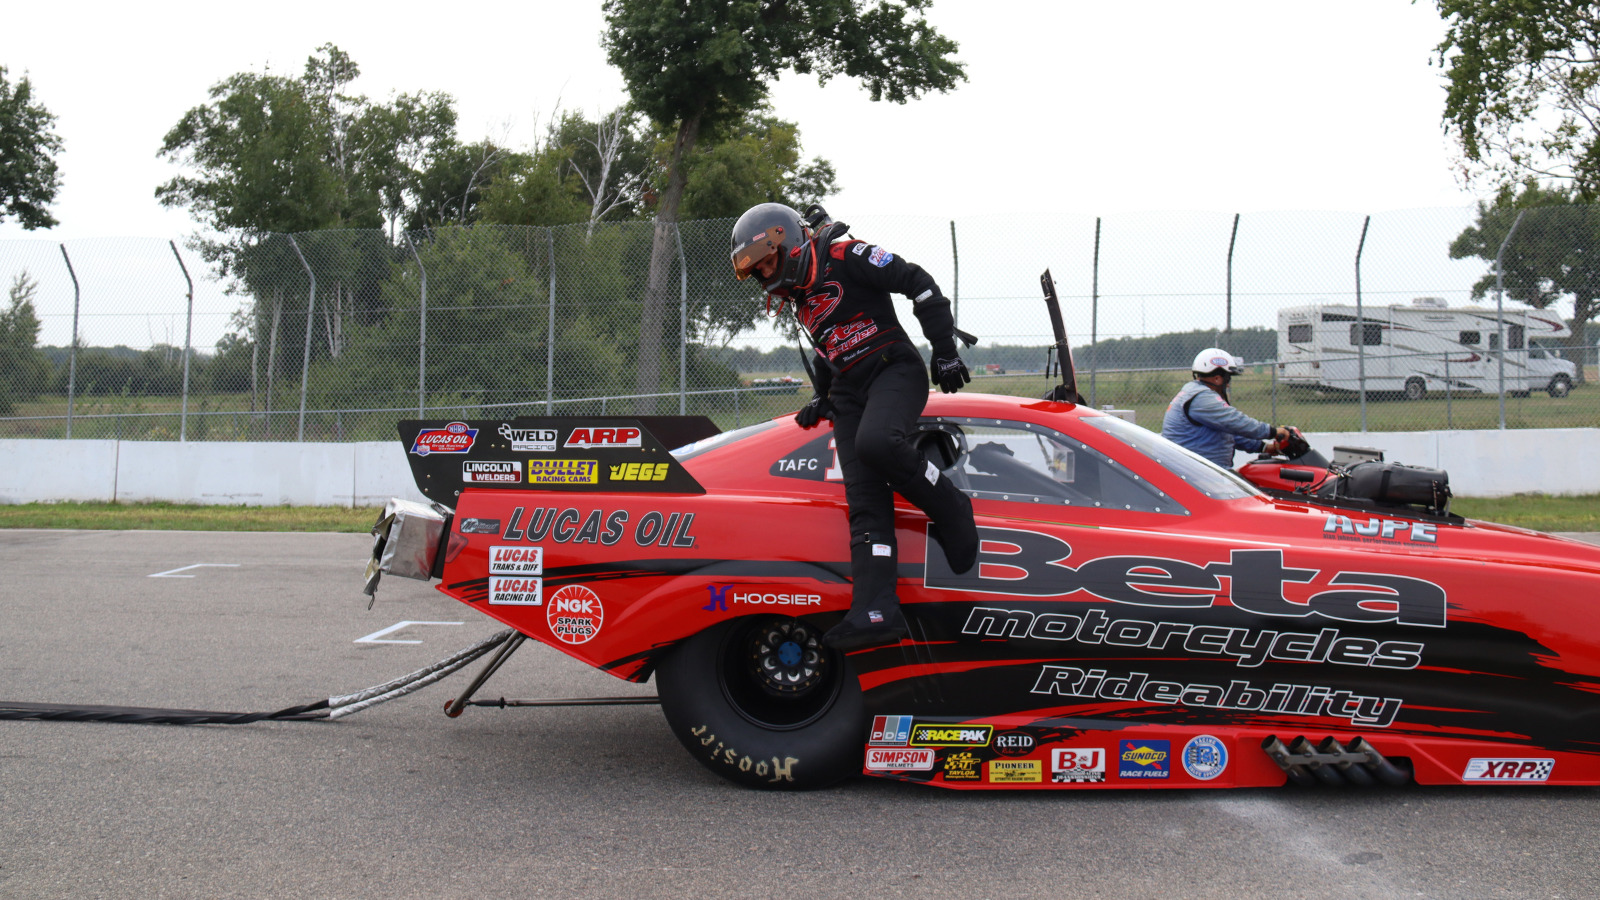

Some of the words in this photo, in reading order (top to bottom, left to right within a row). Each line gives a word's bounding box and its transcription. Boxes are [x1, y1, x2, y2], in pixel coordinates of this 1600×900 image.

[448, 424, 466, 433] NHRA
[420, 434, 453, 444] LUCAS
[452, 434, 468, 444] OIL
[511, 430, 556, 442] WELD
[567, 428, 640, 444] ARP
[466, 463, 512, 473] LINCOLN
[530, 461, 597, 475] BULLET
[778, 458, 818, 472] TAFC
[476, 473, 516, 482] WELDERS
[609, 463, 670, 481] JEGS
[502, 506, 629, 545] LUCAS
[634, 510, 696, 548] OIL
[1323, 514, 1438, 543] AJPE
[494, 549, 538, 562] LUCAS
[492, 563, 515, 571] TRANS
[924, 522, 1446, 628] Beta
[494, 579, 538, 593] LUCAS
[494, 593, 524, 602] RACING
[525, 594, 537, 602] OIL
[733, 593, 821, 605] HOOSIER
[557, 598, 593, 614] NGK
[557, 617, 592, 626] SPARK
[557, 626, 592, 635] PLUGS
[962, 607, 1424, 669] motorcycles
[1030, 665, 1403, 728] Rideability
[872, 731, 908, 740] PDS
[926, 730, 986, 741] RACEPAK
[997, 735, 1034, 748] REID
[872, 751, 929, 763] SIMPSON
[1058, 751, 1099, 770] B&J
[1124, 752, 1165, 760] SUNOCO
[1479, 761, 1537, 778] XRP
